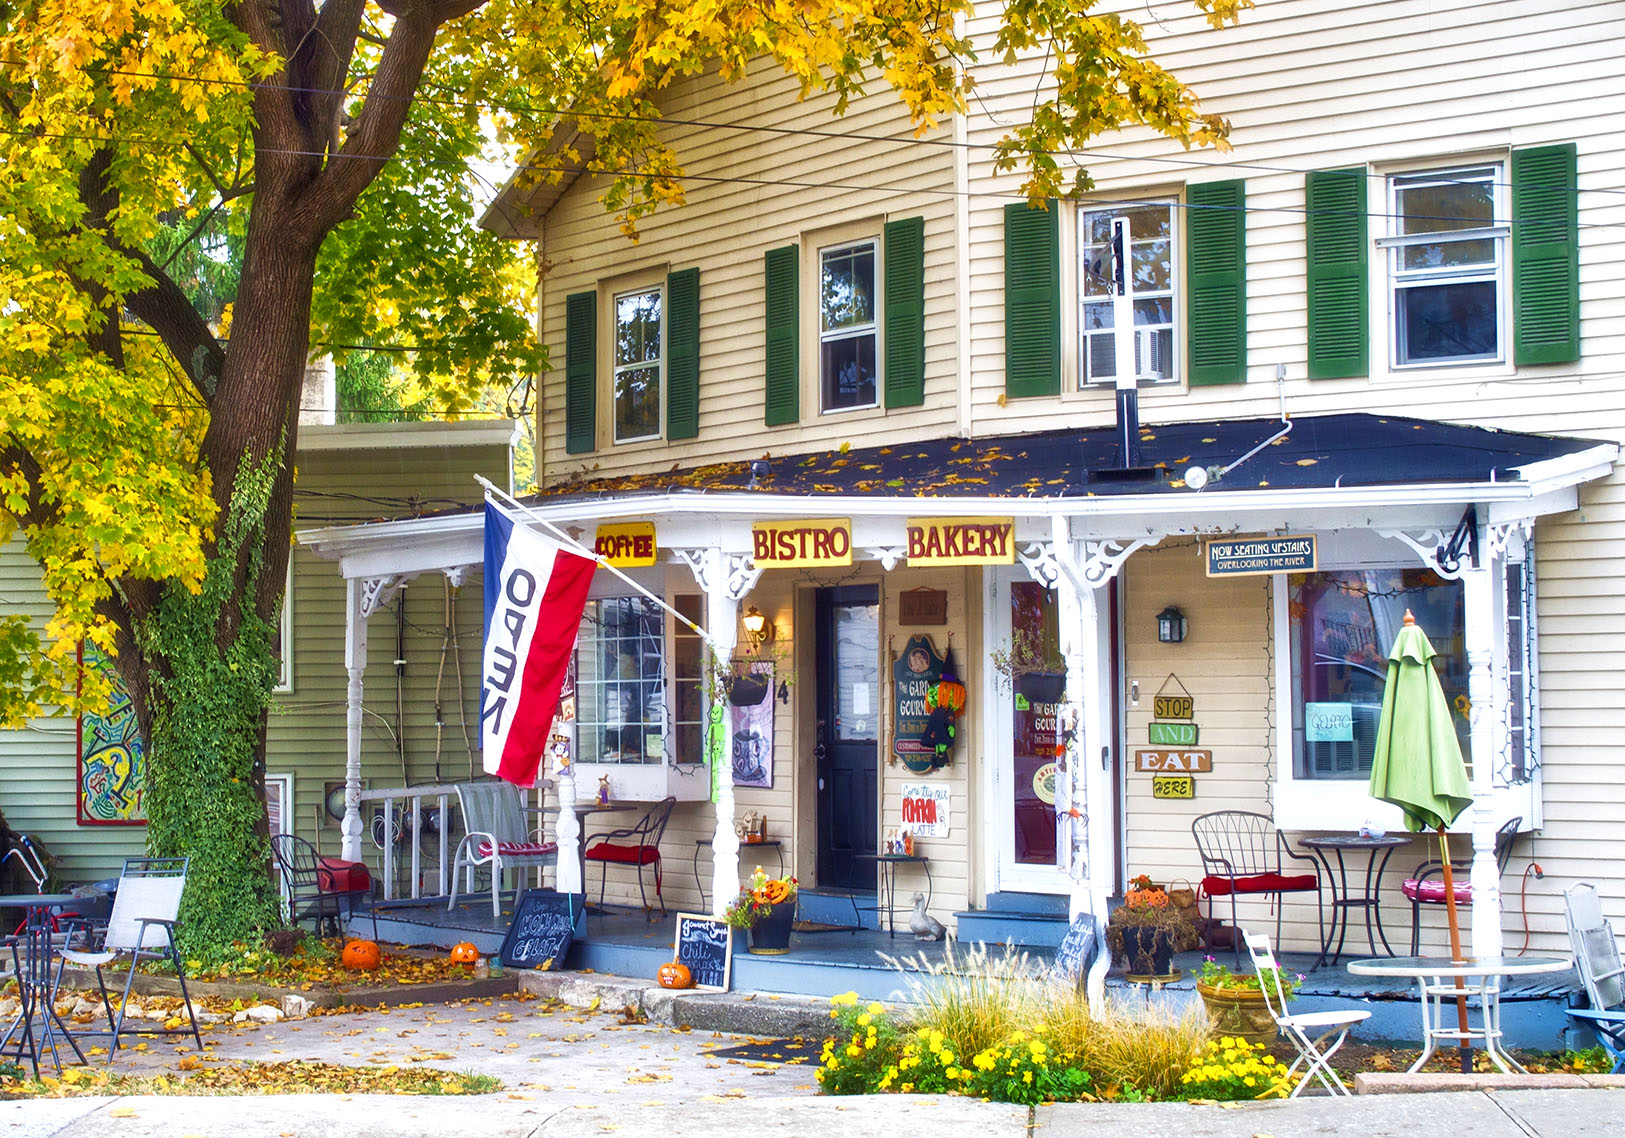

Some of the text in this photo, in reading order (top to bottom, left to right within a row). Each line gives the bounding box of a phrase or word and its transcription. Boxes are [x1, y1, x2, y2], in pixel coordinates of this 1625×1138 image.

[595, 534, 653, 559] COFFEE
[752, 527, 849, 560] BISTRO
[907, 524, 1012, 558] BAKERY
[1211, 540, 1311, 560] NOW SEATING UPSTAIRS
[1217, 556, 1305, 570] OVERLOOKING THE RIVER
[777, 679, 789, 705] 4
[909, 680, 930, 697] GARD
[1156, 698, 1191, 717] STOP
[1154, 726, 1194, 742] AND
[1140, 752, 1206, 770] EAT
[1154, 780, 1192, 796] HERE!
[912, 824, 937, 836] LATTE
[682, 942, 711, 960] Chili
